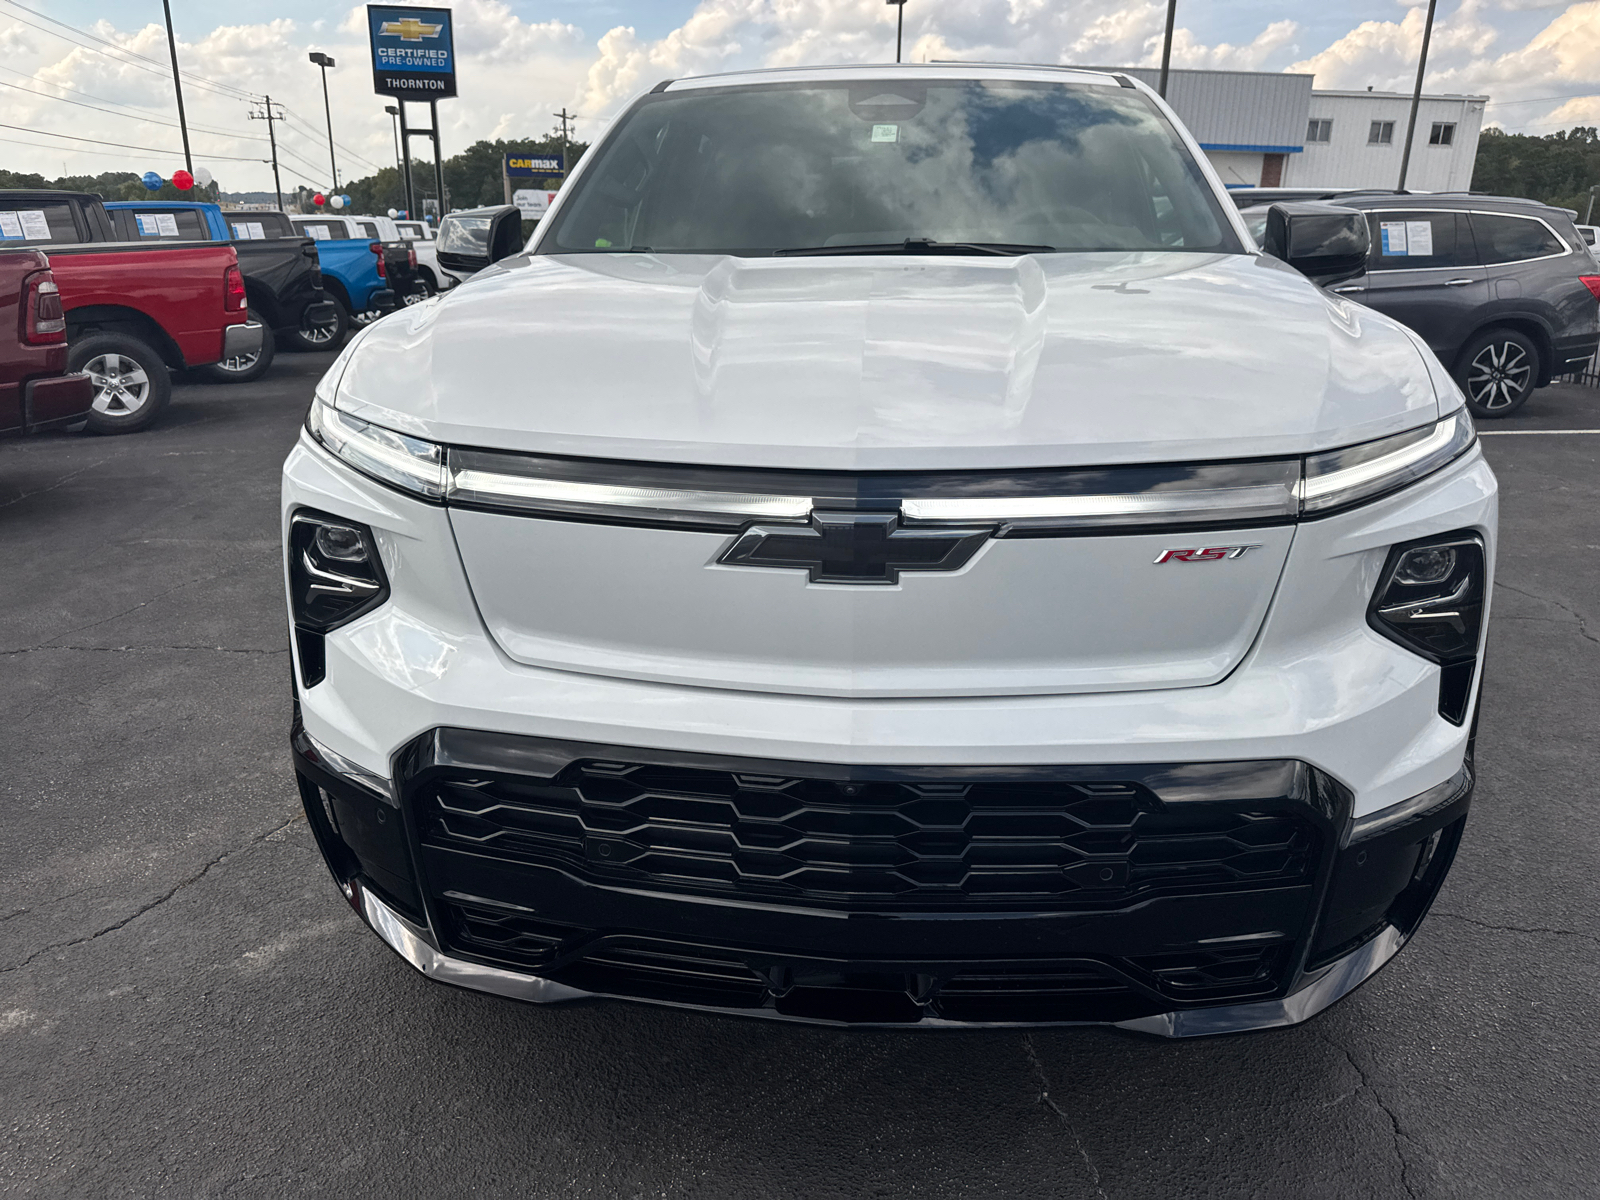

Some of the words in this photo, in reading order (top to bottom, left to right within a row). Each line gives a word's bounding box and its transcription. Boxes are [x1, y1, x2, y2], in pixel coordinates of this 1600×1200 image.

[378, 48, 448, 58] CERTIFIED
[382, 57, 445, 66] PRE-OWNED
[386, 78, 445, 89] THORNTON
[1153, 544, 1262, 564] RST
